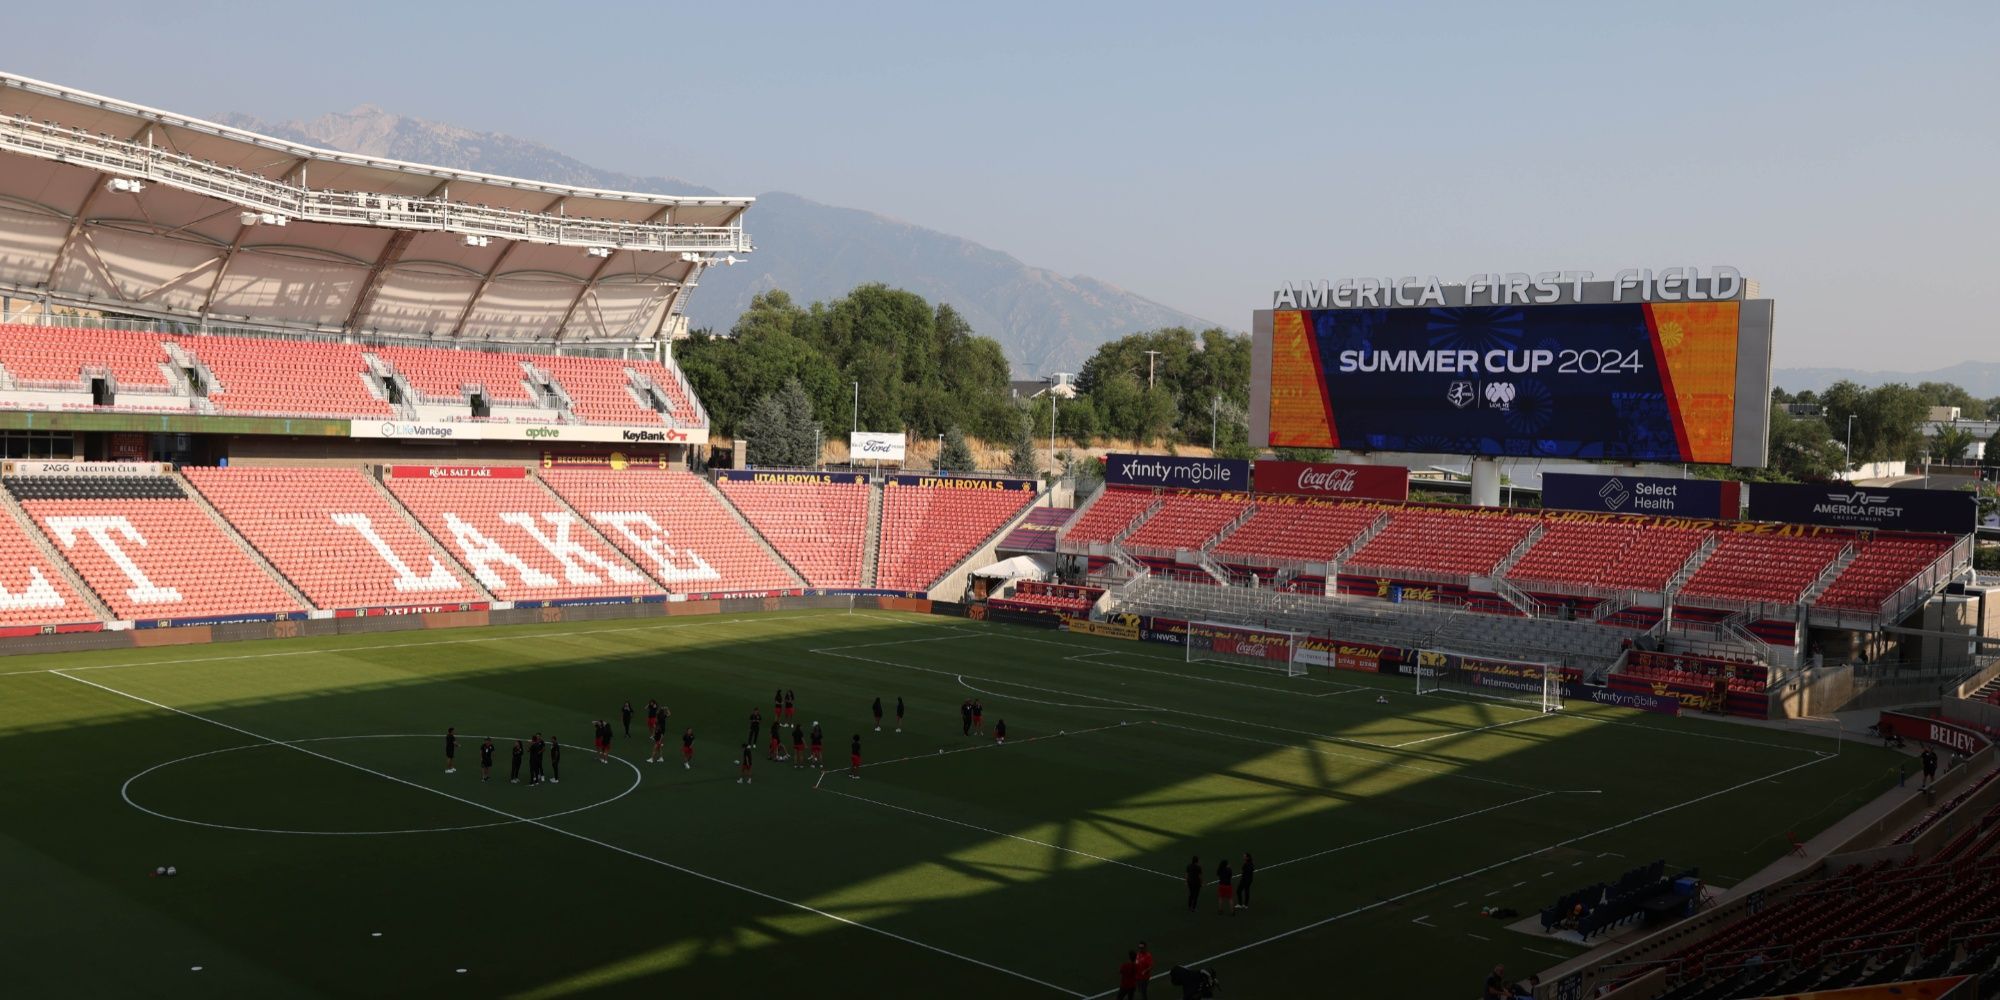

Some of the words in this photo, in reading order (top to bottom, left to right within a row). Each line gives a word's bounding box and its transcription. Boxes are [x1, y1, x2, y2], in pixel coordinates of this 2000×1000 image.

[1273, 276, 1446, 309] AMERICA
[1464, 270, 1595, 306] FIRST
[1612, 265, 1742, 301] FIELD
[1338, 349, 1479, 374] SUMMER
[1484, 348, 1554, 373] CUP
[1557, 349, 1644, 374] 2024
[396, 424, 452, 437] LifeVantage
[525, 426, 560, 439] aptive
[622, 429, 666, 442] KeyBank
[863, 439, 892, 453] Ford
[557, 456, 609, 464] BECKERMAN'S
[630, 457, 653, 465] BLOCK
[42, 464, 70, 472] ZAGG
[75, 465, 116, 473] EXECUTIVE
[117, 464, 138, 473] CLUB
[429, 466, 449, 478] REAL
[449, 468, 470, 477] SALT
[470, 466, 492, 477] LAKE
[1121, 459, 1172, 482] xfinity
[1174, 462, 1231, 484] mobile
[754, 473, 786, 484] UTAH
[786, 475, 832, 485] ROYALS
[919, 477, 955, 489] UTAH
[955, 479, 1004, 491] ROYALS
[1298, 467, 1358, 493] Coca-Cola
[1635, 482, 1678, 498] Select
[1633, 496, 1675, 511] Health
[1813, 504, 1866, 516] AMERICA
[1867, 506, 1904, 518] FIRST
[329, 511, 722, 592] LAKE
[1156, 633, 1179, 643] NWSL
[1399, 664, 1412, 674] NIKE
[1482, 677, 1542, 693] Intermountain
[1591, 689, 1622, 703] xfinity
[1623, 694, 1658, 708] mobile
[1930, 724, 1975, 754] BELIEVE
